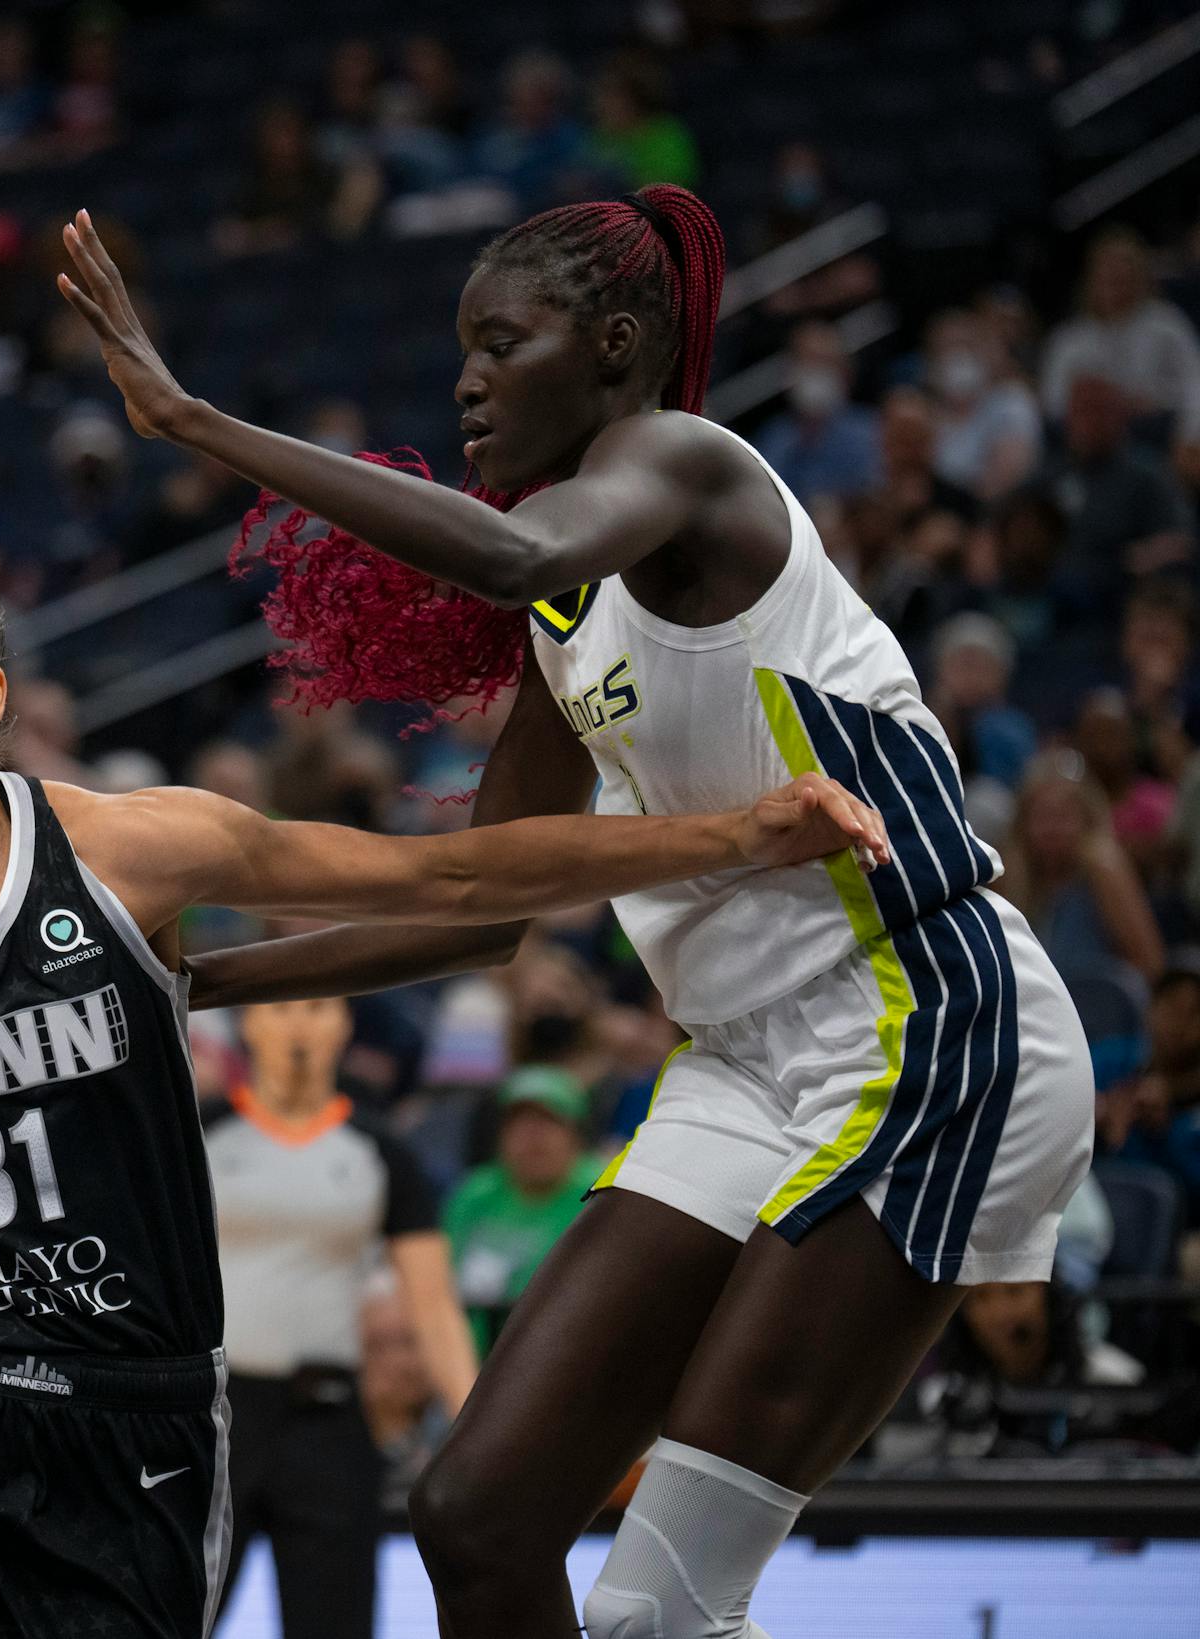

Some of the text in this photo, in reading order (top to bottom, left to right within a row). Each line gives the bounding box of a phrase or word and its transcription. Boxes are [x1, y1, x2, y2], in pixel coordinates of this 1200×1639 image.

[559, 652, 644, 742] INGS
[42, 943, 104, 974] sharecare
[2, 1373, 71, 1396] MINNESOTA
